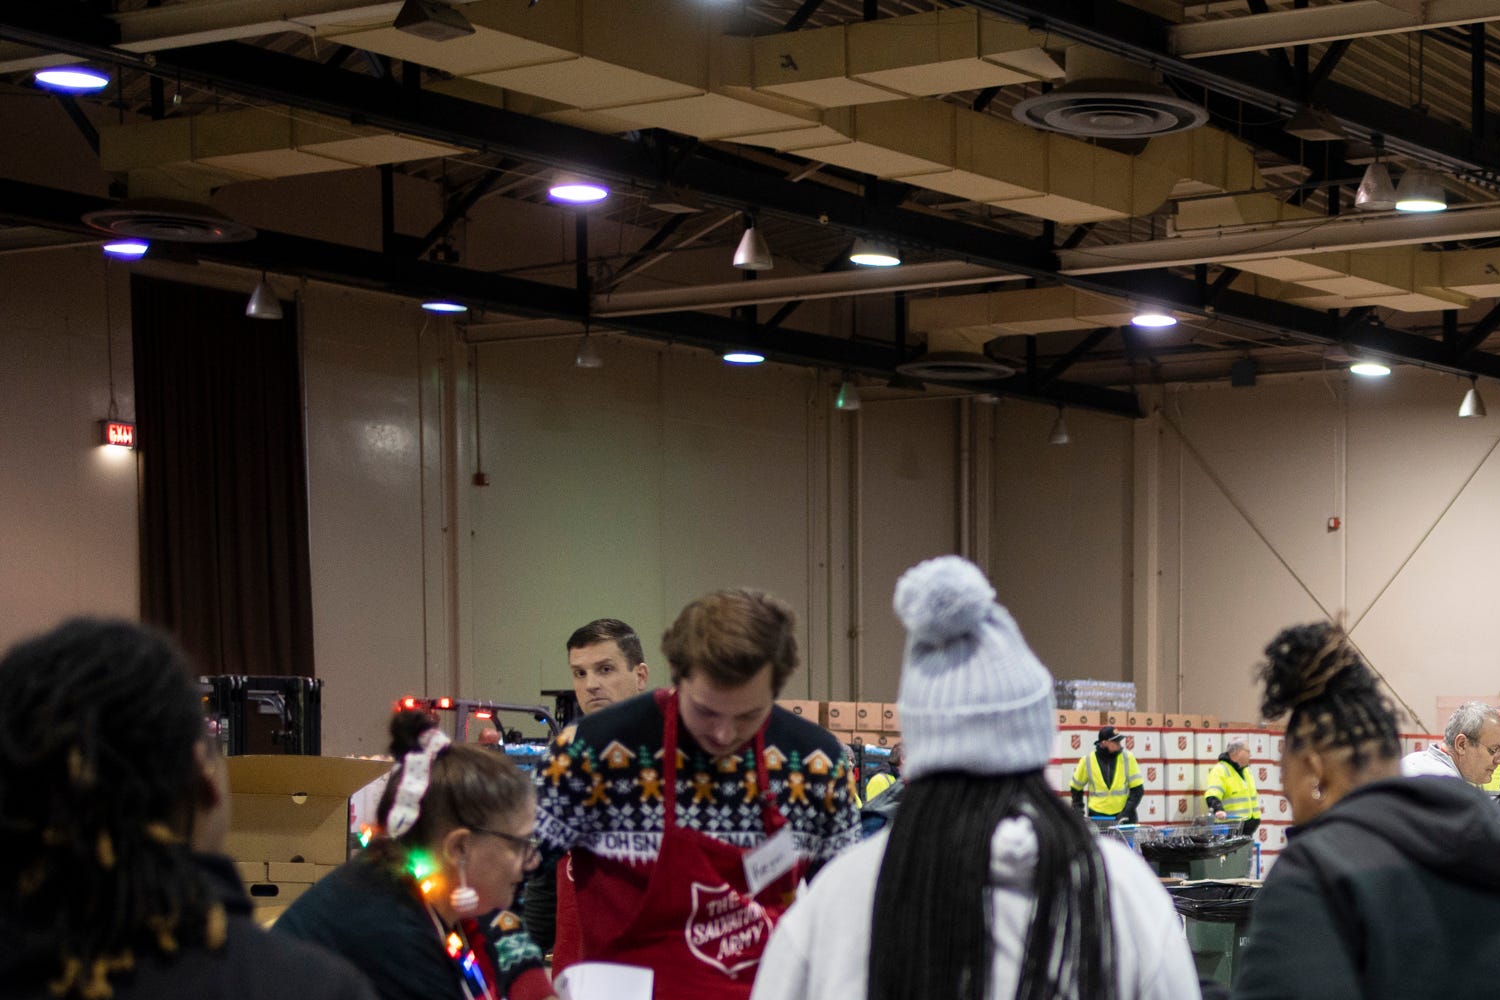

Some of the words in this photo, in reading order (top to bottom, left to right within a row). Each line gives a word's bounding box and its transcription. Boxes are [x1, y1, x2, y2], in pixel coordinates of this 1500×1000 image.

[109, 424, 133, 444] EXIT
[633, 835, 658, 852] SN
[706, 889, 740, 917] THE
[717, 921, 764, 960] ARMY
